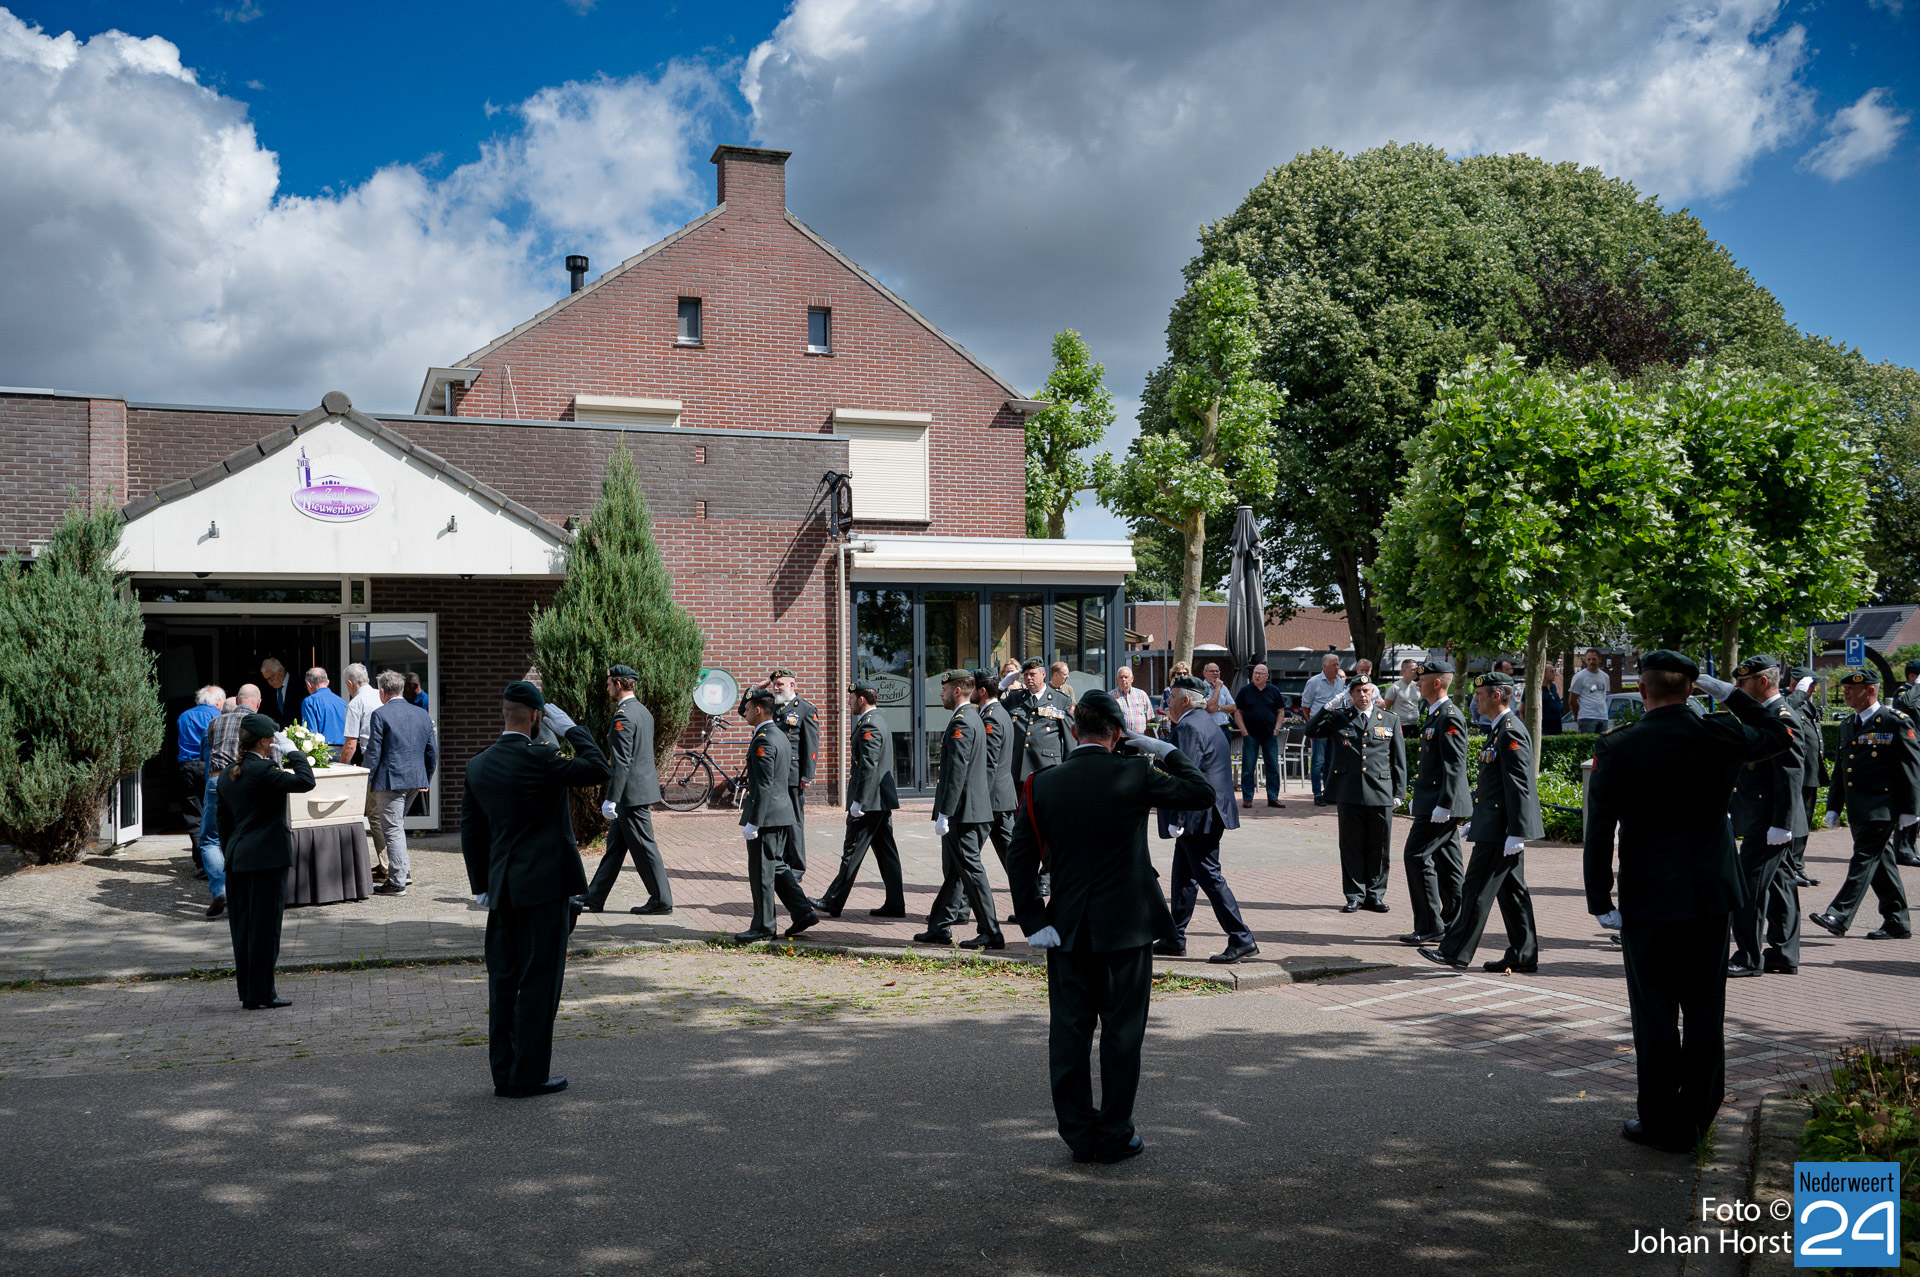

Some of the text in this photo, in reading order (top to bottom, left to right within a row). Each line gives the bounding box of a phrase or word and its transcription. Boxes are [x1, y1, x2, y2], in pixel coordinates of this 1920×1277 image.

[325, 487, 348, 498] Zaal
[301, 491, 372, 515] Nieuwenhoven
[1849, 640, 1859, 654] P
[876, 686, 906, 701] erschil
[880, 681, 895, 692] Café
